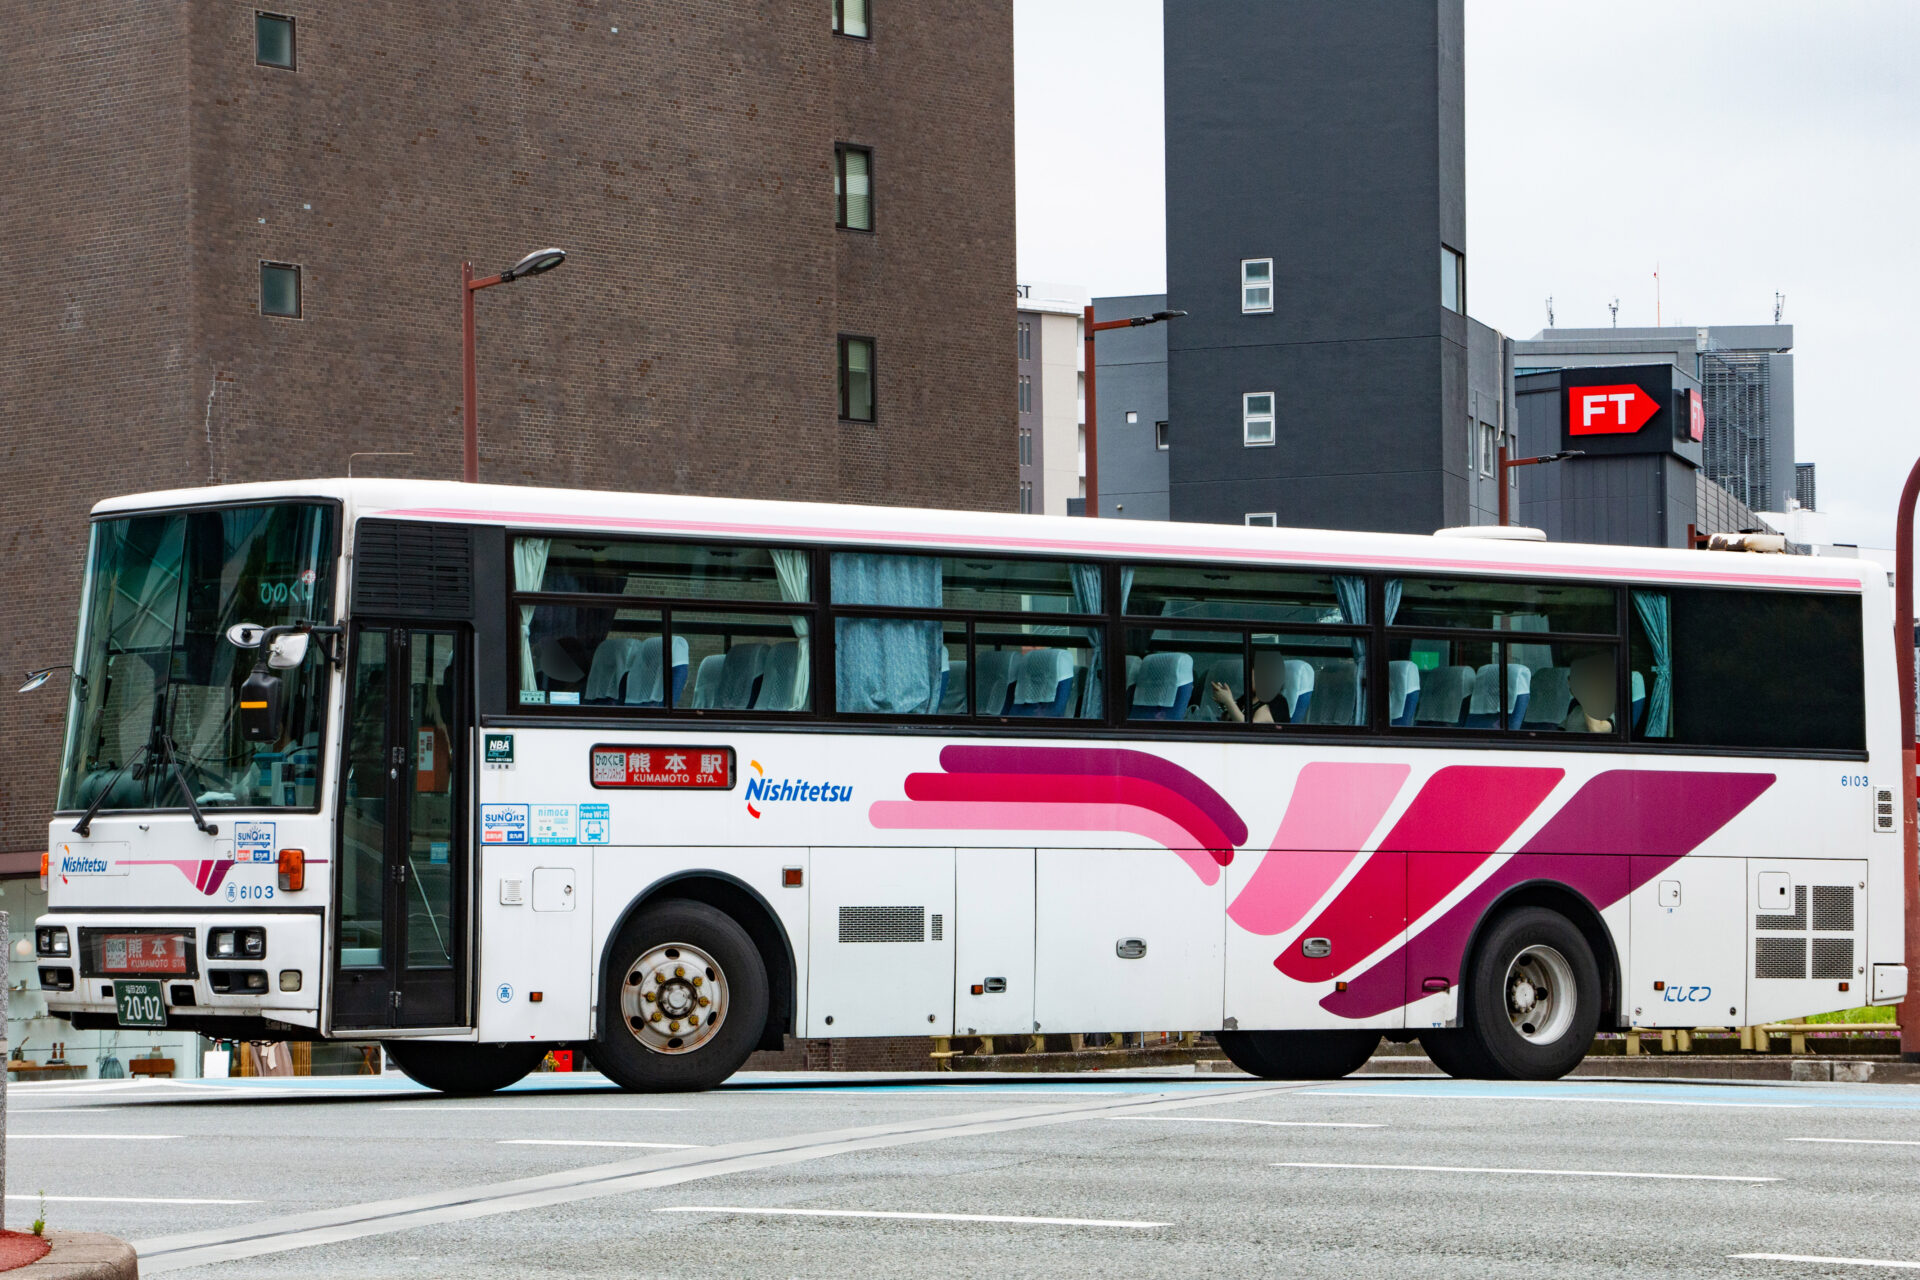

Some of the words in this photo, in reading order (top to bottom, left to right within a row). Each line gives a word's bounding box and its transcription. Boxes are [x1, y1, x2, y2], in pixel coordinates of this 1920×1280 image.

[1582, 392, 1636, 427] FT
[1692, 400, 1702, 433] FT
[489, 740, 510, 751] NBA
[628, 753, 723, 774] 熊本駅
[633, 774, 690, 783] KUMAMOTO
[695, 774, 718, 783] STA.
[1841, 775, 1869, 787] 6103
[744, 777, 854, 802] Nishitetsu
[538, 807, 569, 817] nimoca
[61, 857, 107, 873] Nishitetsu
[240, 886, 274, 899] 6103
[130, 959, 169, 968] KUMAMOTO
[1663, 986, 1712, 1002] にしてつ
